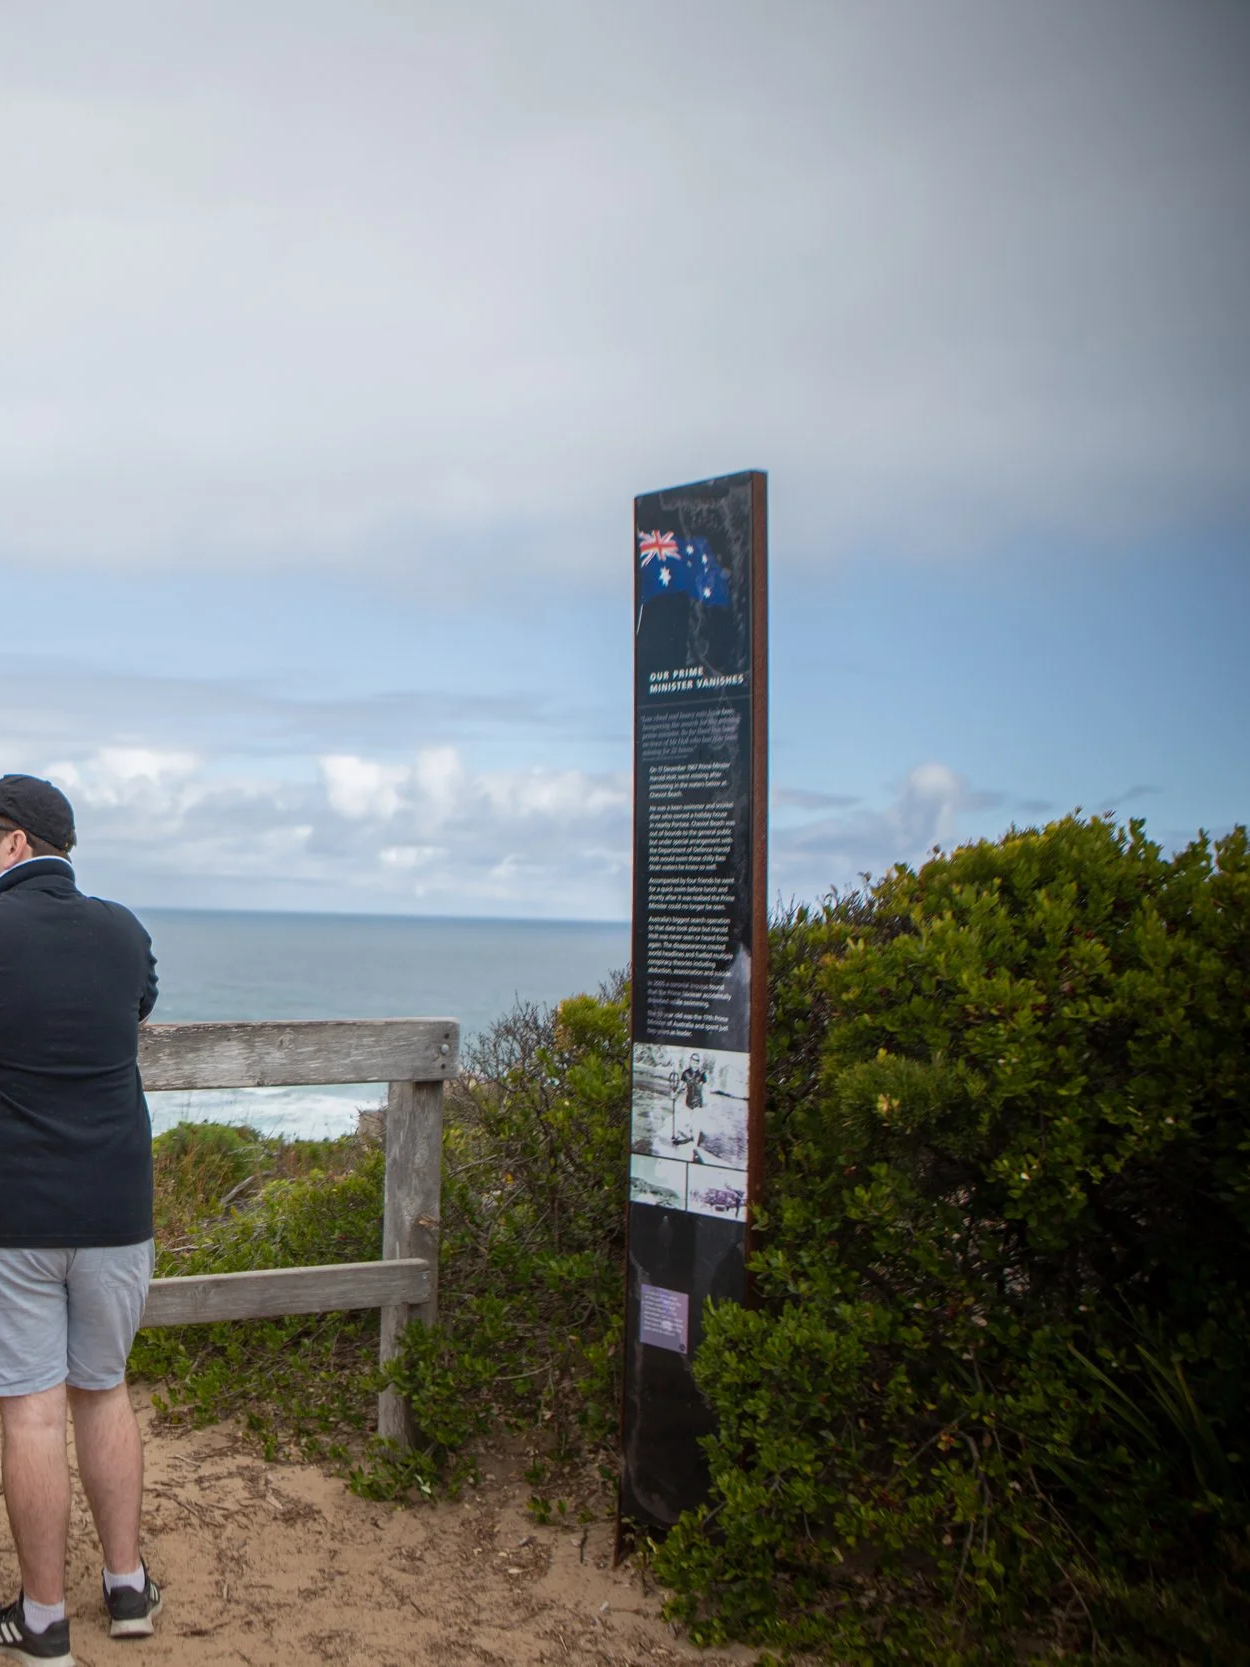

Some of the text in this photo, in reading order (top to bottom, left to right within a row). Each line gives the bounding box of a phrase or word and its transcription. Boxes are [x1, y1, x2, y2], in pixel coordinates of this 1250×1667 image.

[649, 666, 704, 682] OUR PRIME
[649, 673, 744, 694] MINISTER VANISHES
